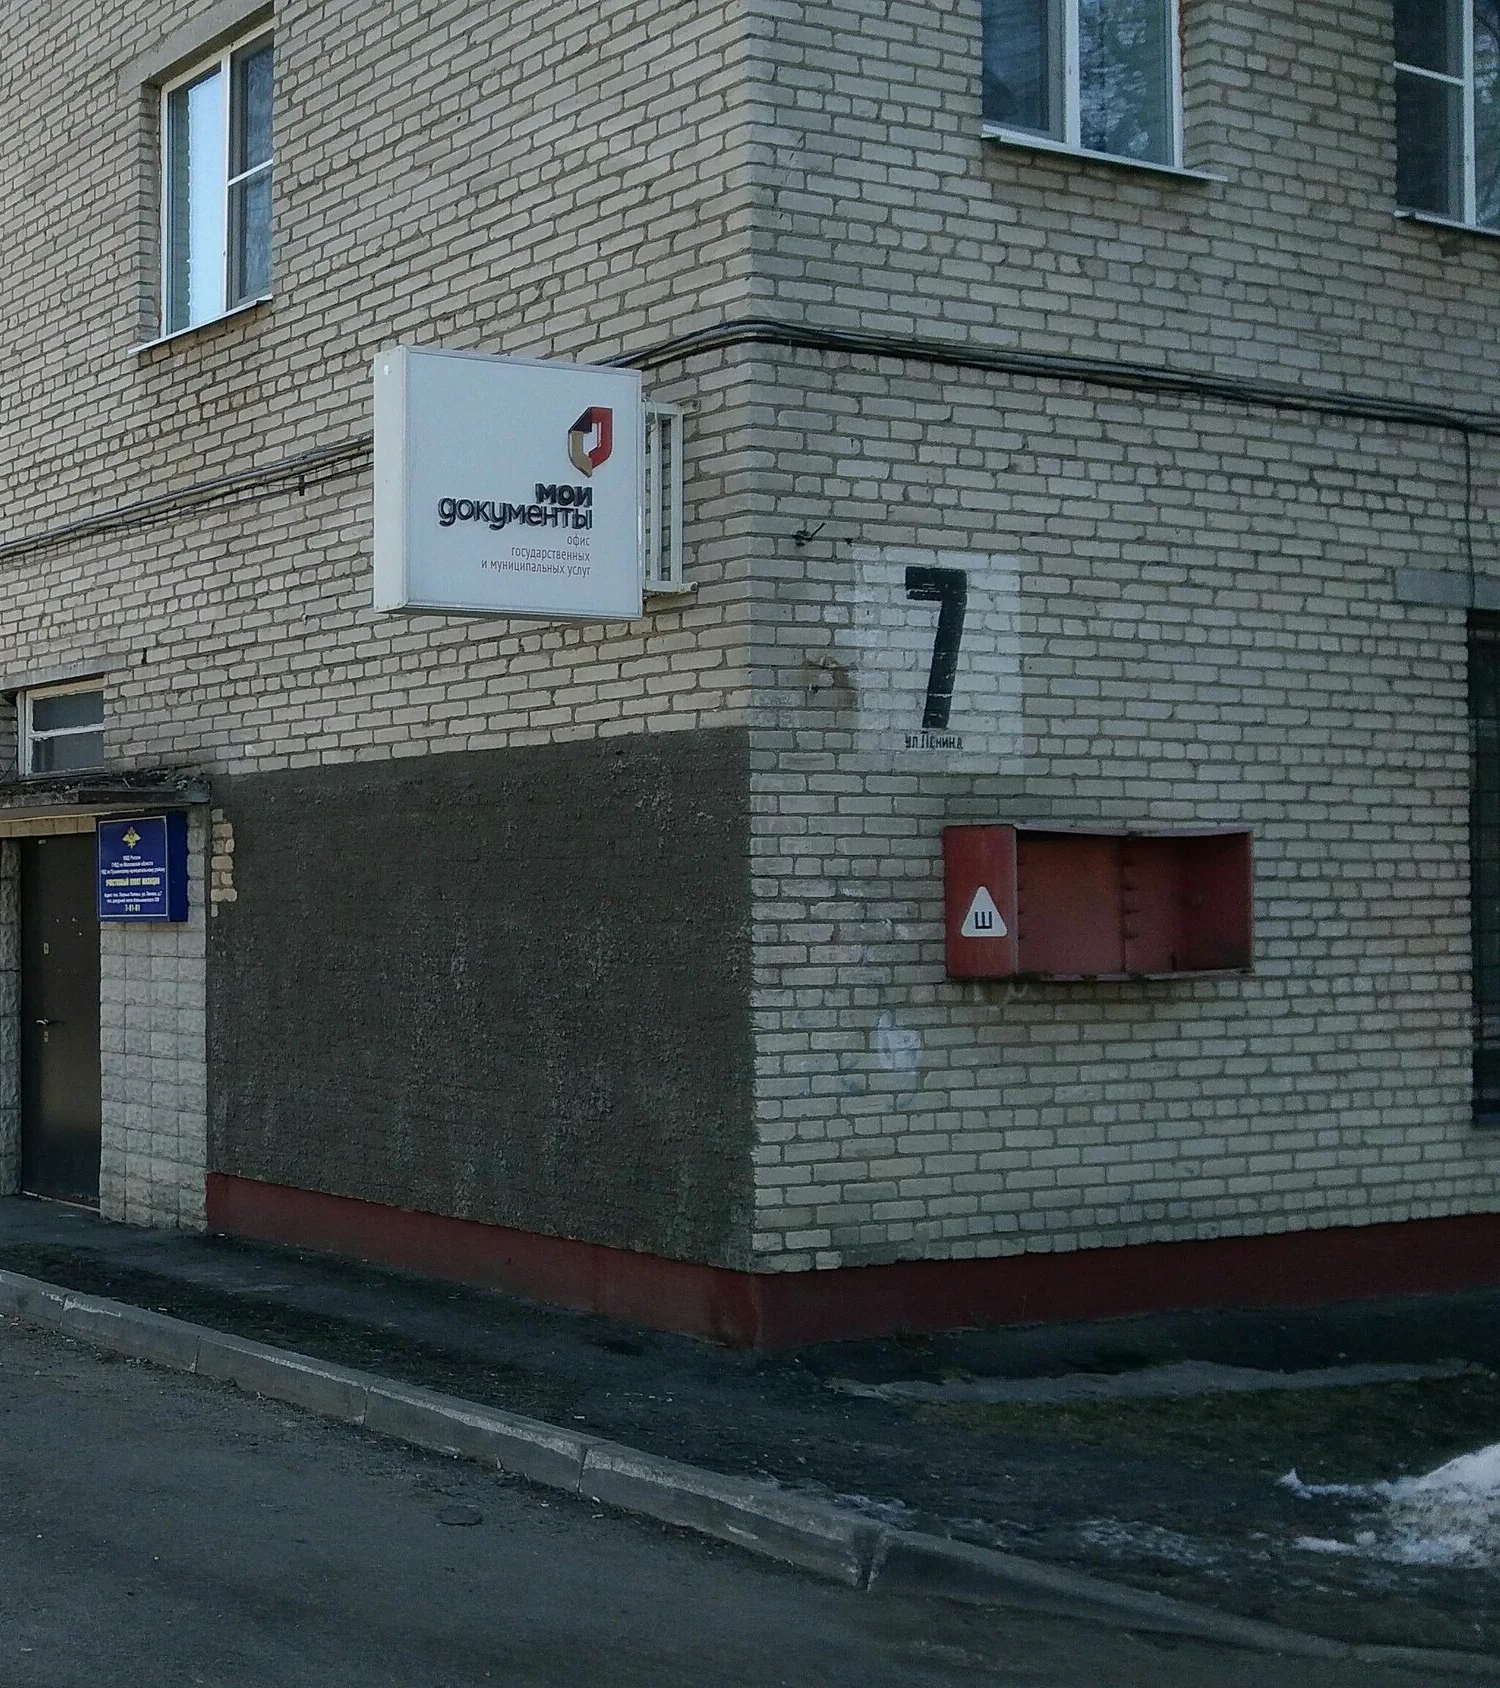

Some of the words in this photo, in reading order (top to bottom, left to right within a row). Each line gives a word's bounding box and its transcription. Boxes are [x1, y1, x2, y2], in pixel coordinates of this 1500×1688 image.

[535, 482, 593, 507] мои
[438, 497, 593, 530] документы
[567, 535, 590, 548] офис
[511, 547, 590, 562] государственных
[481, 559, 487, 569] и
[490, 560, 565, 575] муниципальных
[567, 565, 591, 579] услуг
[905, 566, 967, 728] 7
[975, 911, 992, 929] Ш
